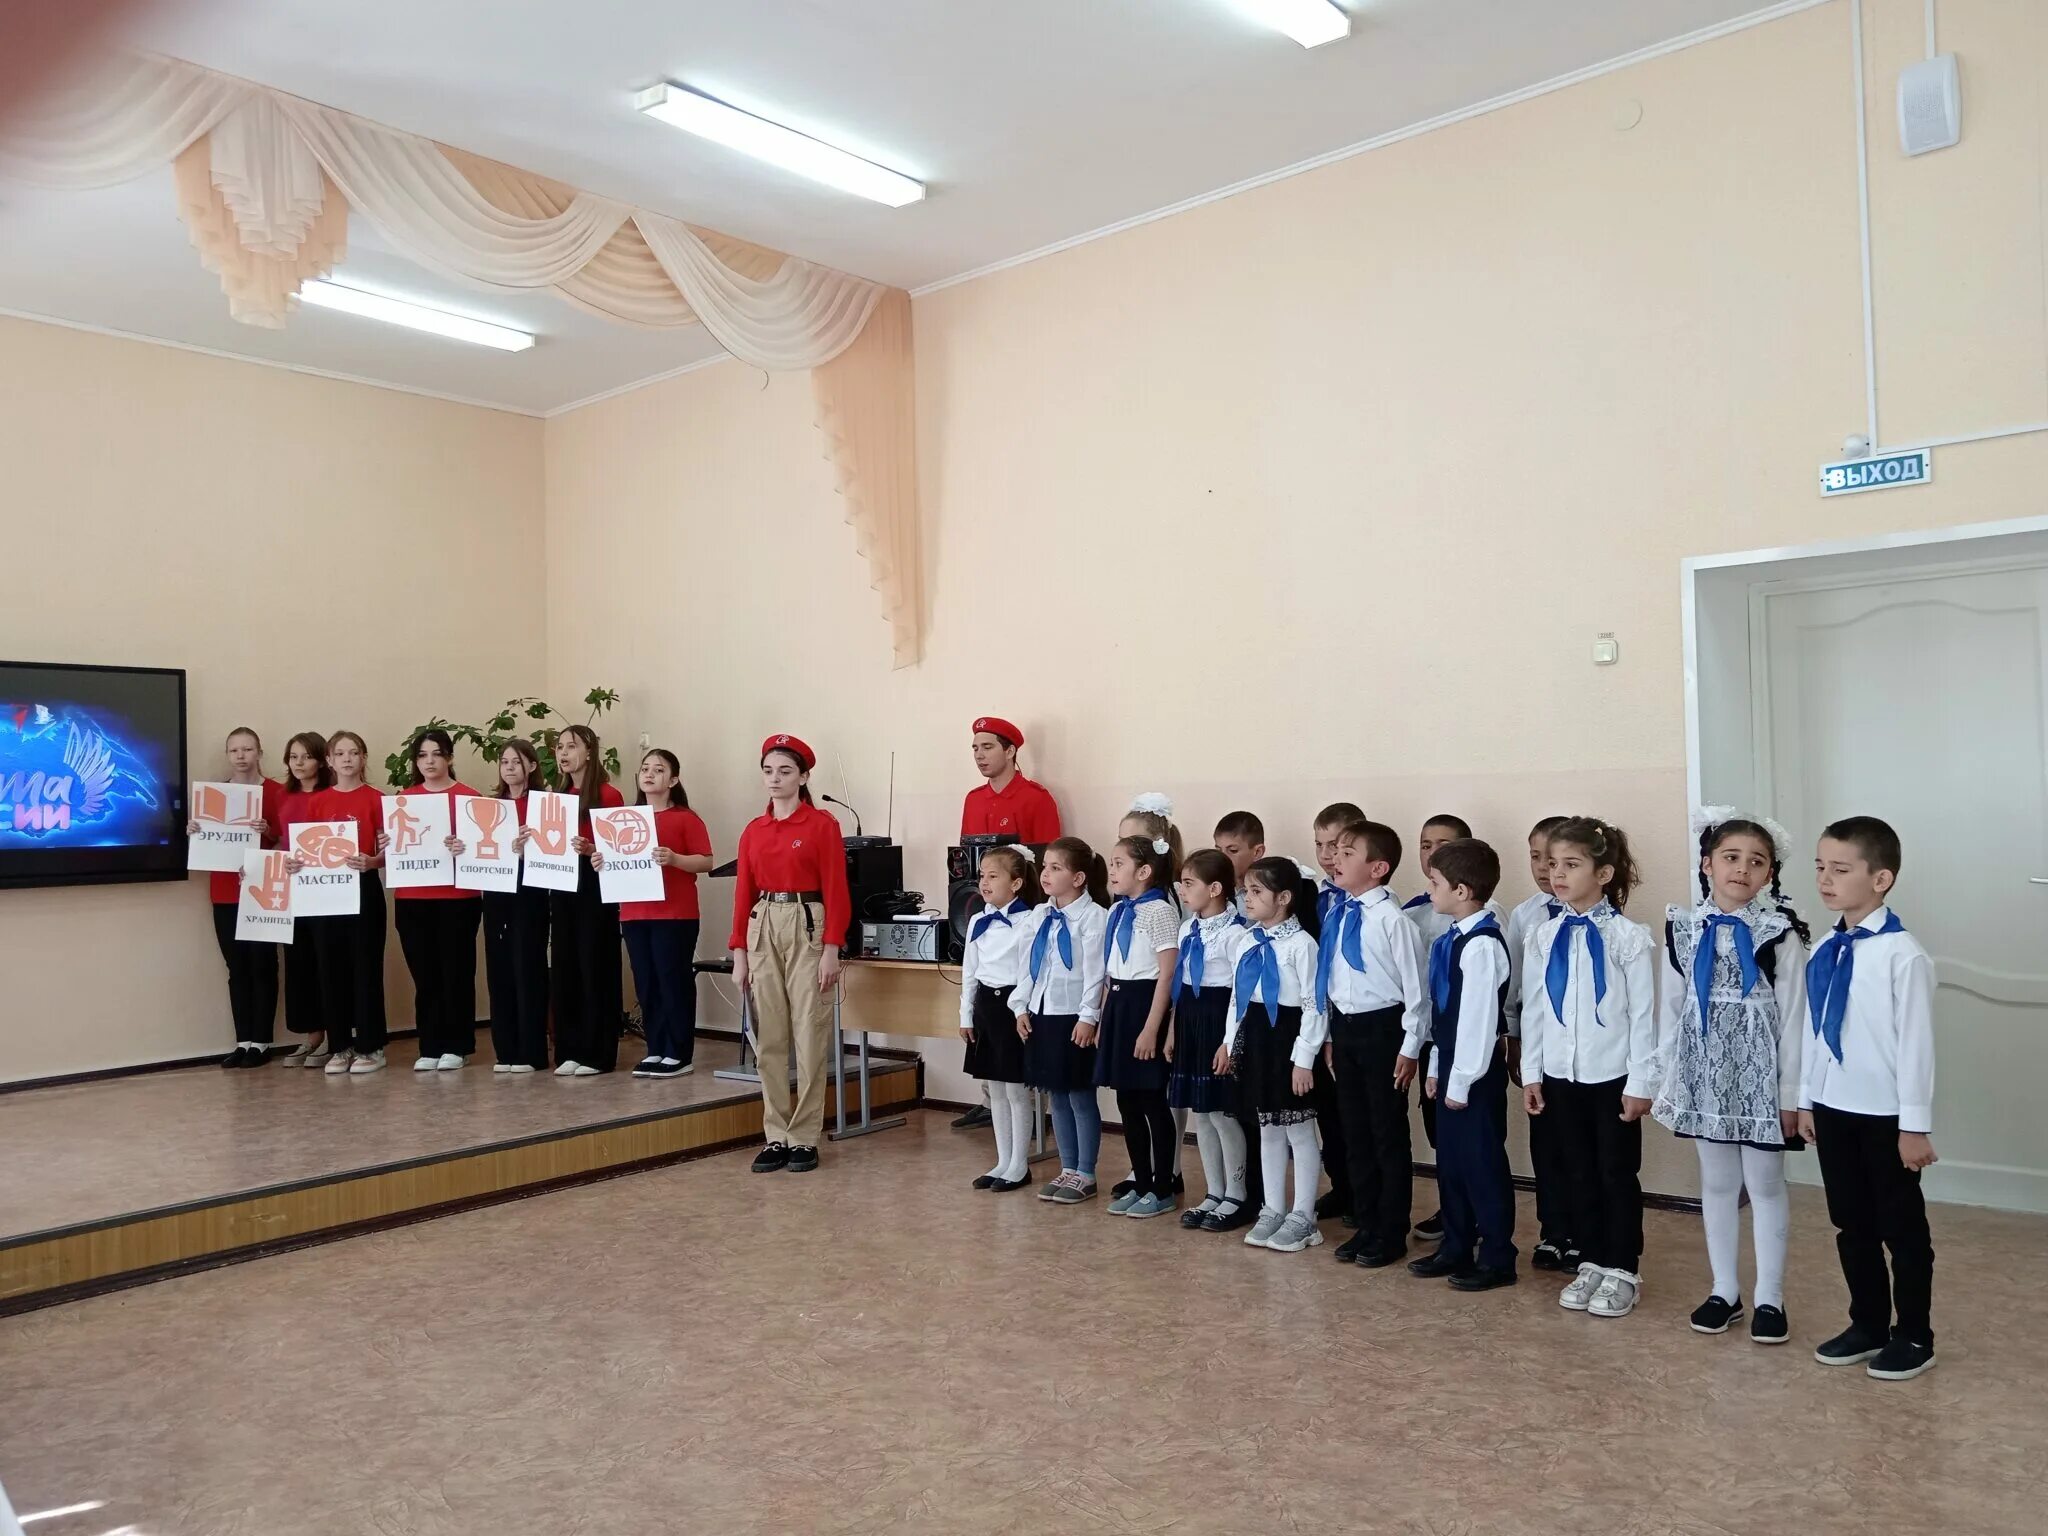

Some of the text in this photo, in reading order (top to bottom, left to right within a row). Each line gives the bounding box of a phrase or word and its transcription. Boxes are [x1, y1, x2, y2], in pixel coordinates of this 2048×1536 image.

[1829, 458, 1920, 489] ВЫХОД
[198, 831, 252, 843] ЭРУДИТ
[396, 859, 440, 871] ЛИДЕР
[460, 865, 514, 875] СПОРТСМЕН
[528, 861, 574, 873] ДОБРОВОЛЕЦ
[603, 859, 654, 871] ЭКОЛОГ
[298, 874, 353, 885] МАСТЕР
